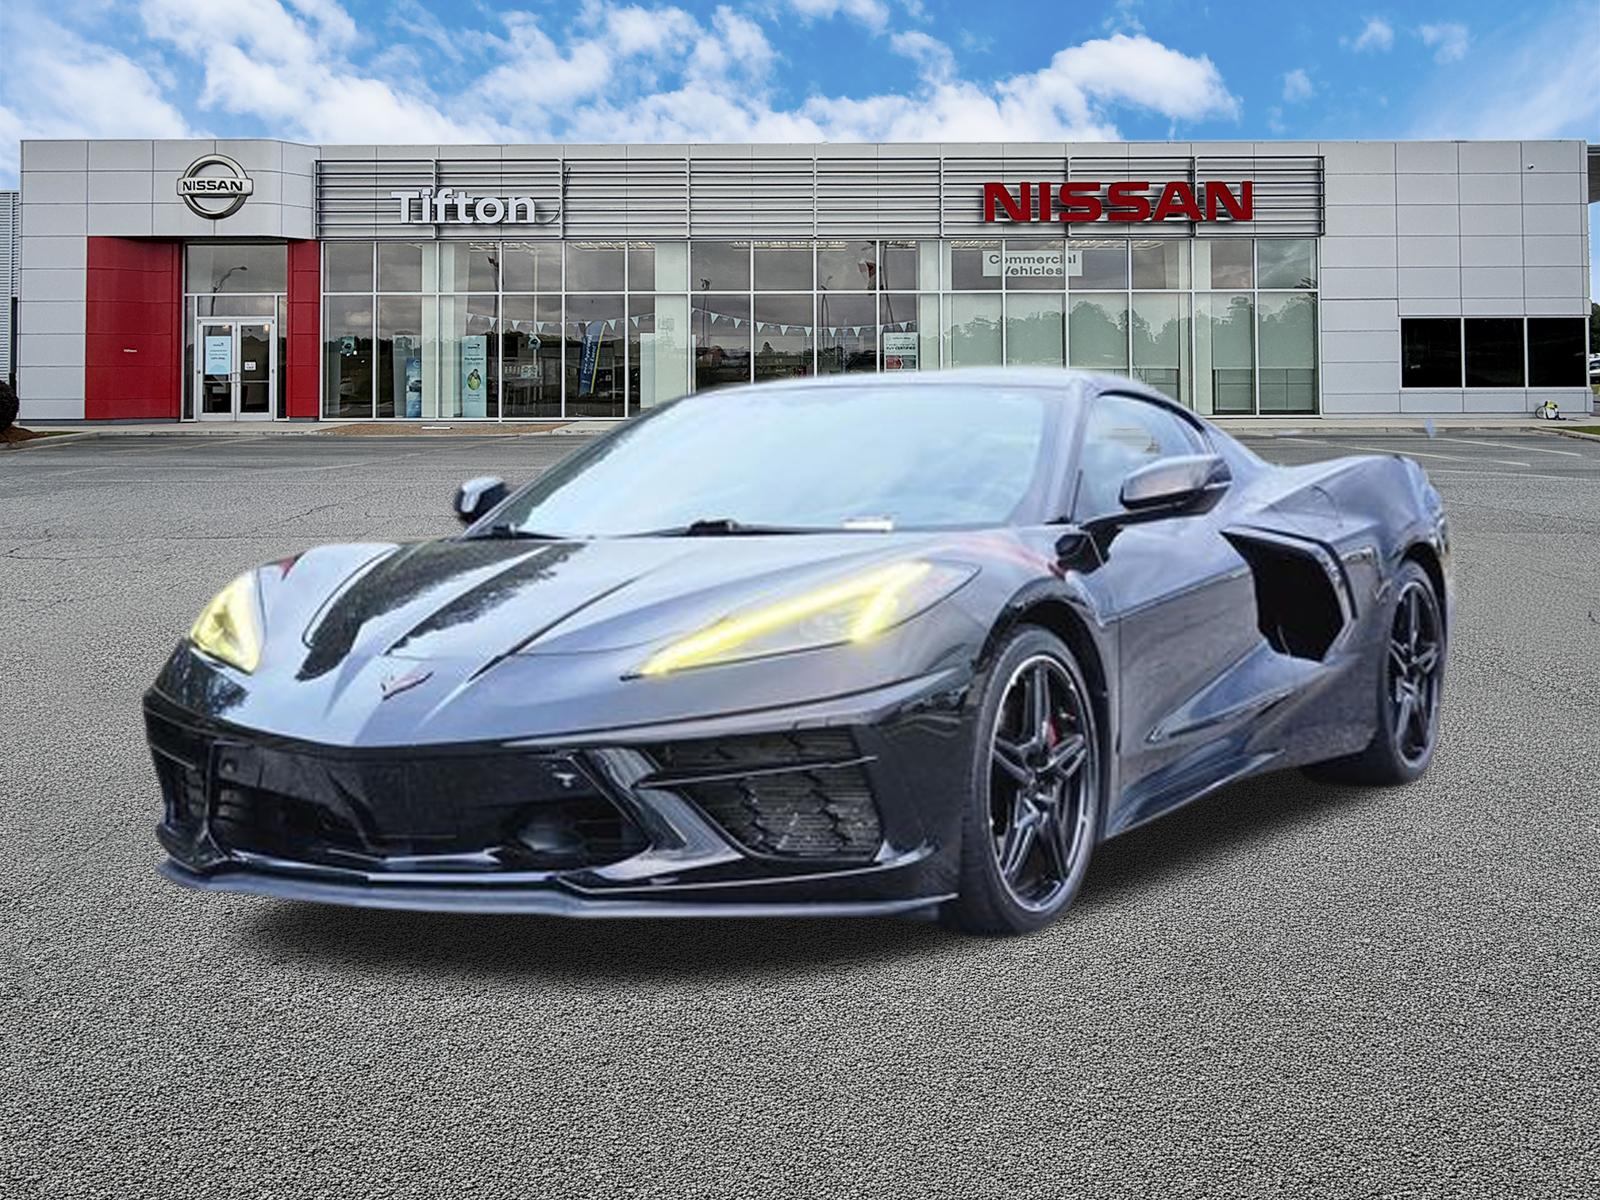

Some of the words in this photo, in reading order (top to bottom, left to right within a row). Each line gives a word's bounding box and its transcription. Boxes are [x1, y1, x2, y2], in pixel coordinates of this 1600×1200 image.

[182, 180, 243, 191] NISSAN
[984, 181, 1254, 221] NISSAN
[391, 188, 536, 224] Tifton
